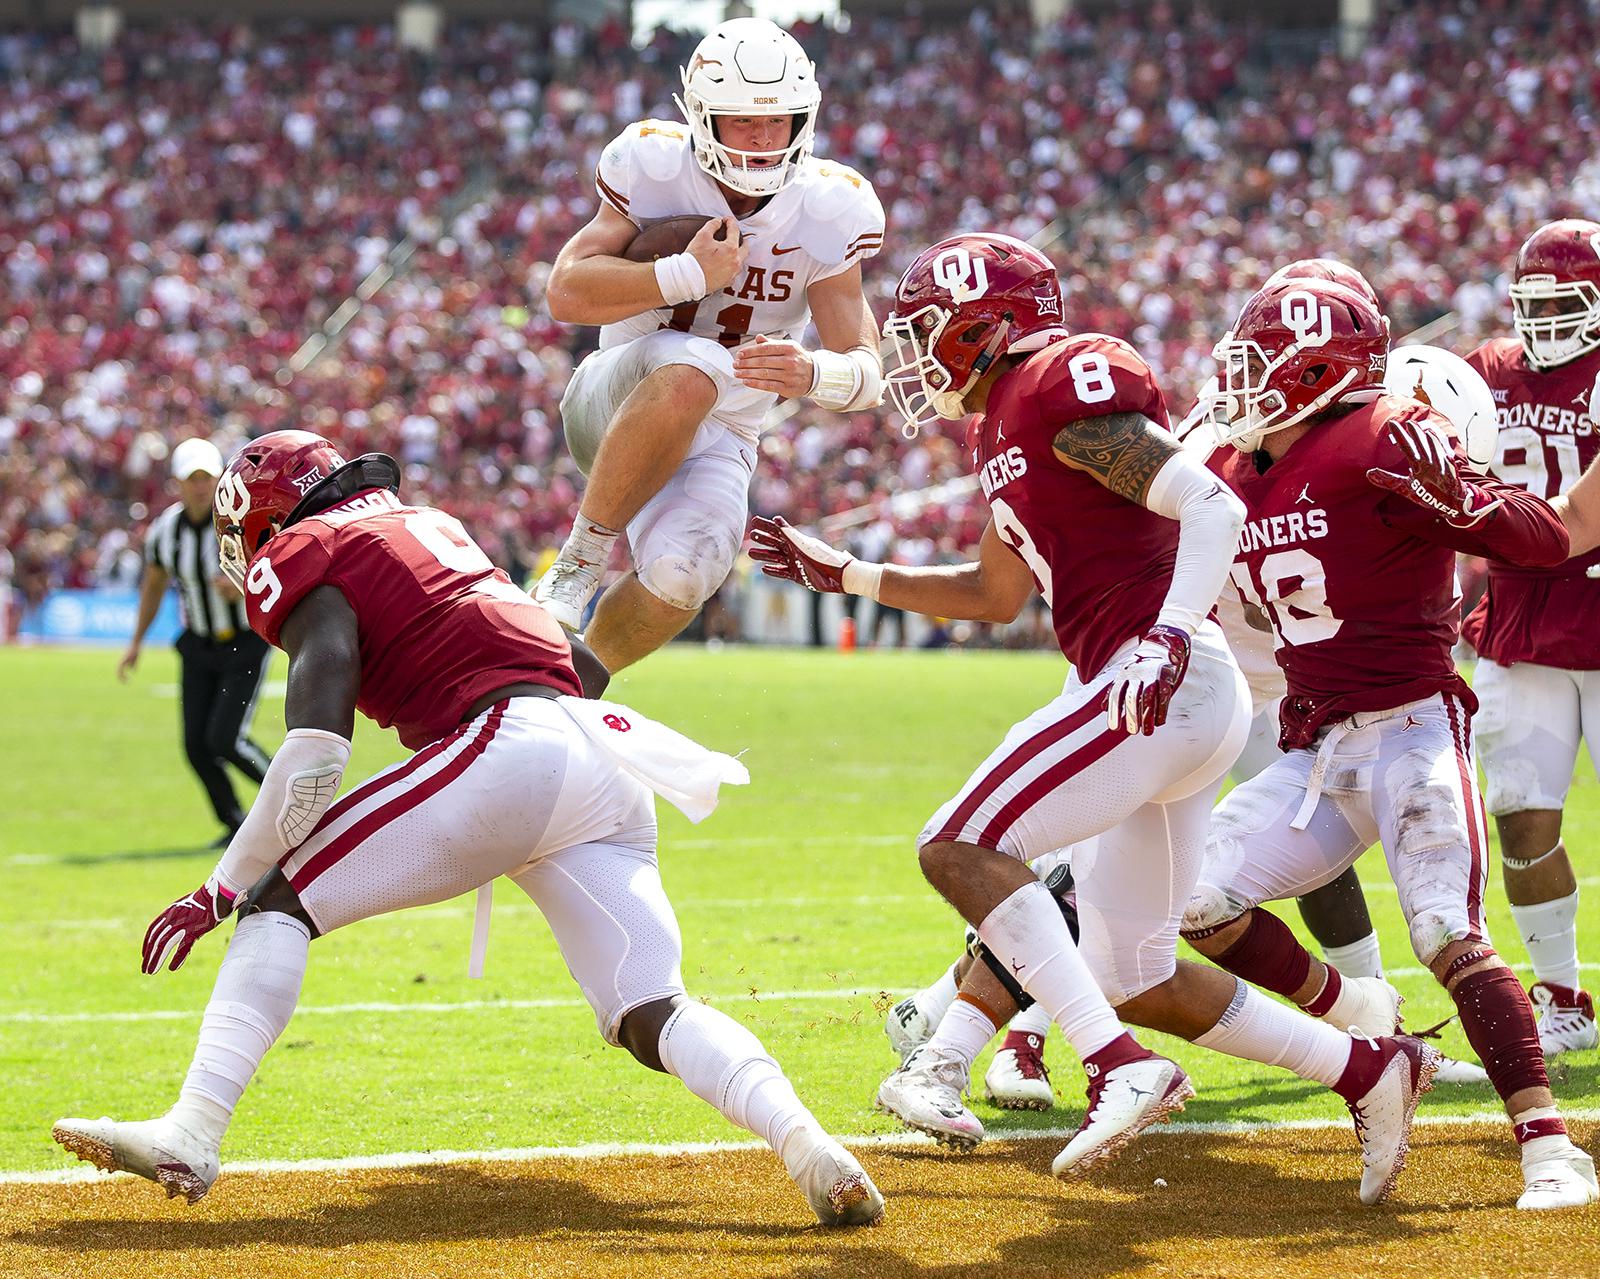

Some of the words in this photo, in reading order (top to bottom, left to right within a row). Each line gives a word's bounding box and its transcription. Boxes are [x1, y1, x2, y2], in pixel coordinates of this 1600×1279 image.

[753, 96, 778, 105] HORNS
[932, 247, 989, 304] OU
[1280, 290, 1333, 348] OU
[1068, 352, 1116, 404] 8
[979, 446, 1028, 501] NERS
[1489, 426, 1582, 501] 91
[214, 471, 251, 520] OU
[1410, 478, 1459, 519] SOONER
[247, 556, 283, 614] 9
